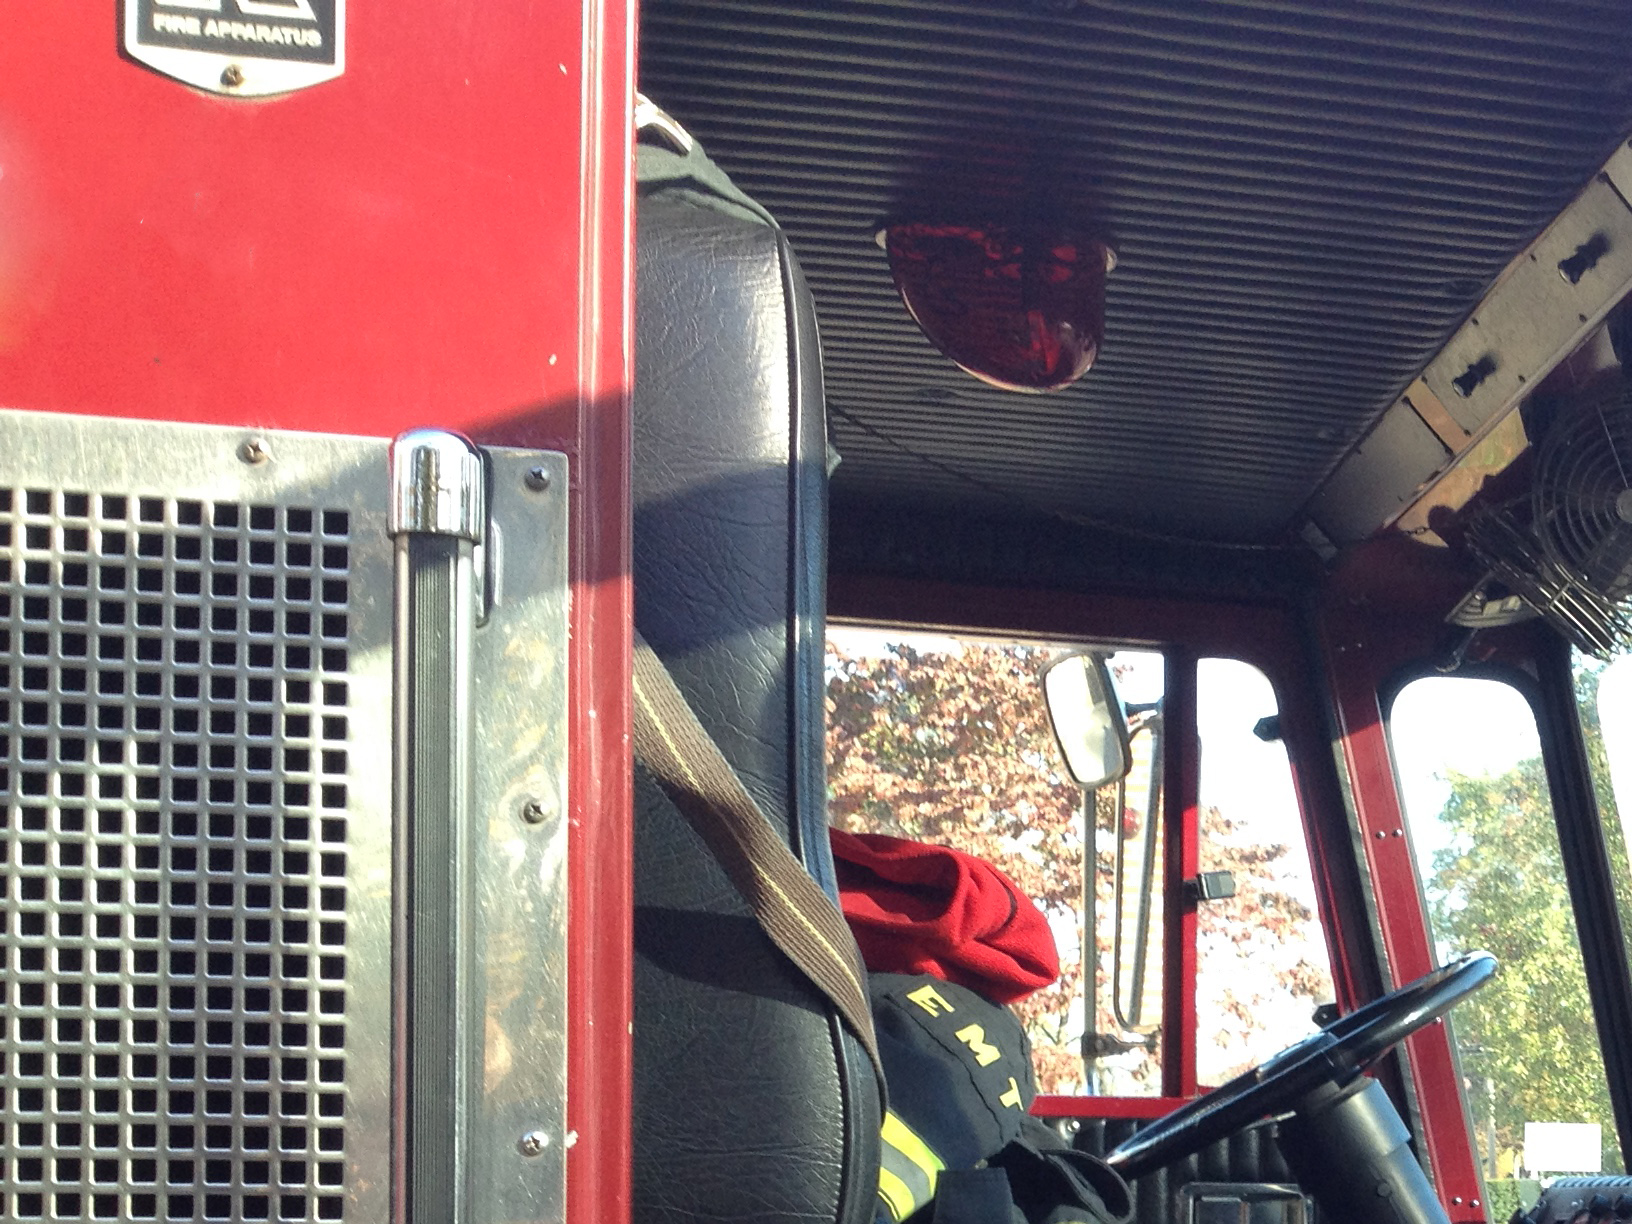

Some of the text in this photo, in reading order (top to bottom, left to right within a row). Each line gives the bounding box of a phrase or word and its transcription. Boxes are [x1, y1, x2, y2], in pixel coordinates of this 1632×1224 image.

[153, 12, 322, 48] FIRE APPARATUS
[906, 984, 1025, 1112] EMT
